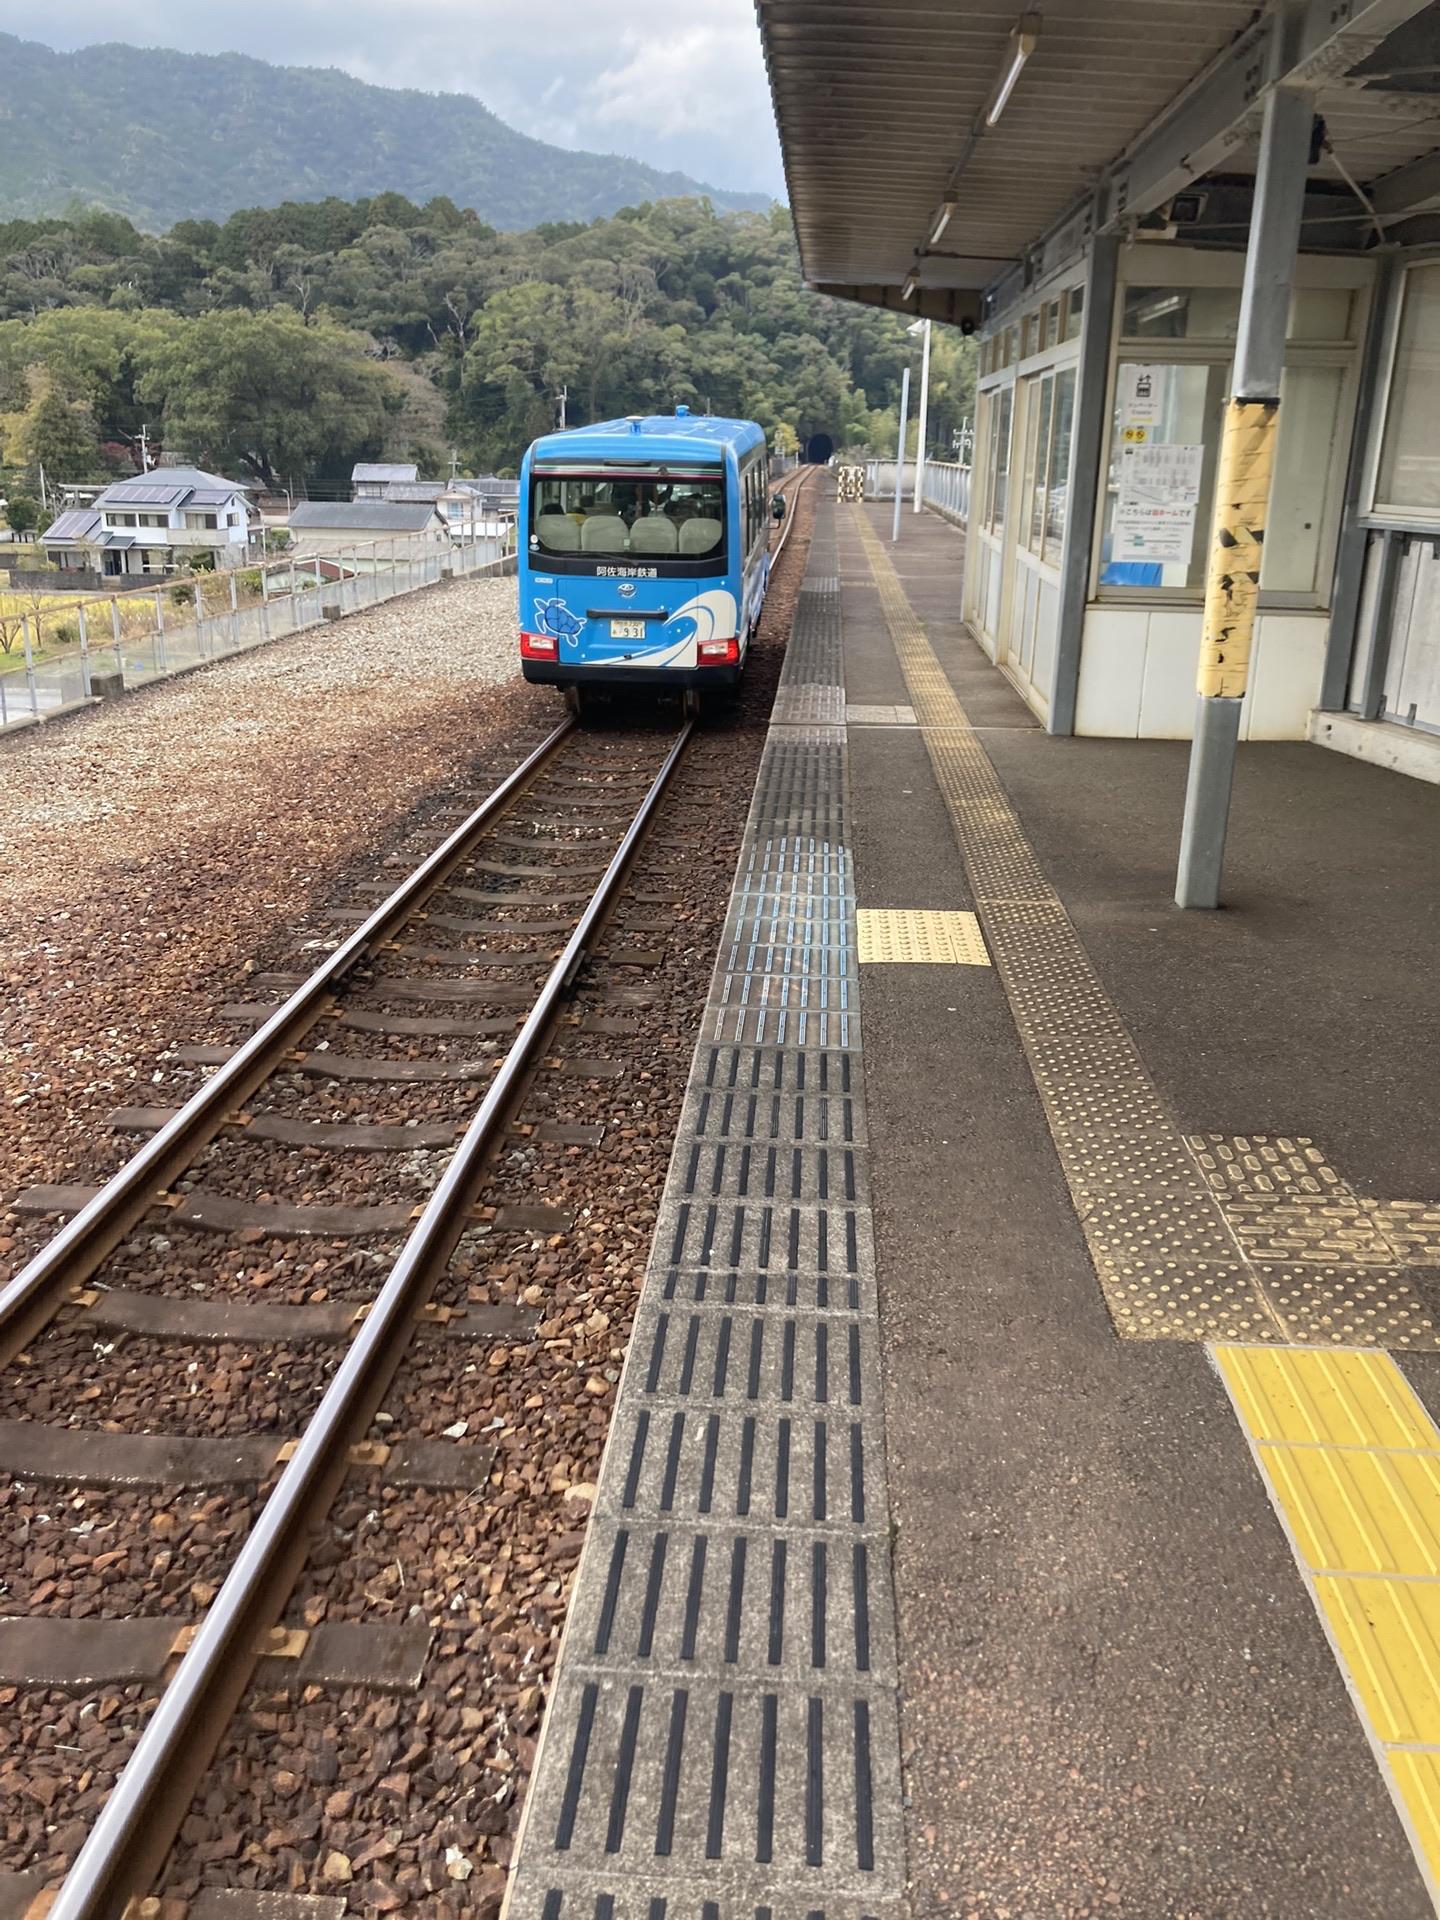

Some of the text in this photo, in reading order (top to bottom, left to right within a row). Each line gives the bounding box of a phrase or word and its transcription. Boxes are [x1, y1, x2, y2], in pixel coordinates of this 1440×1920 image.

[596, 566, 658, 578] 阿佐海岸鉄道
